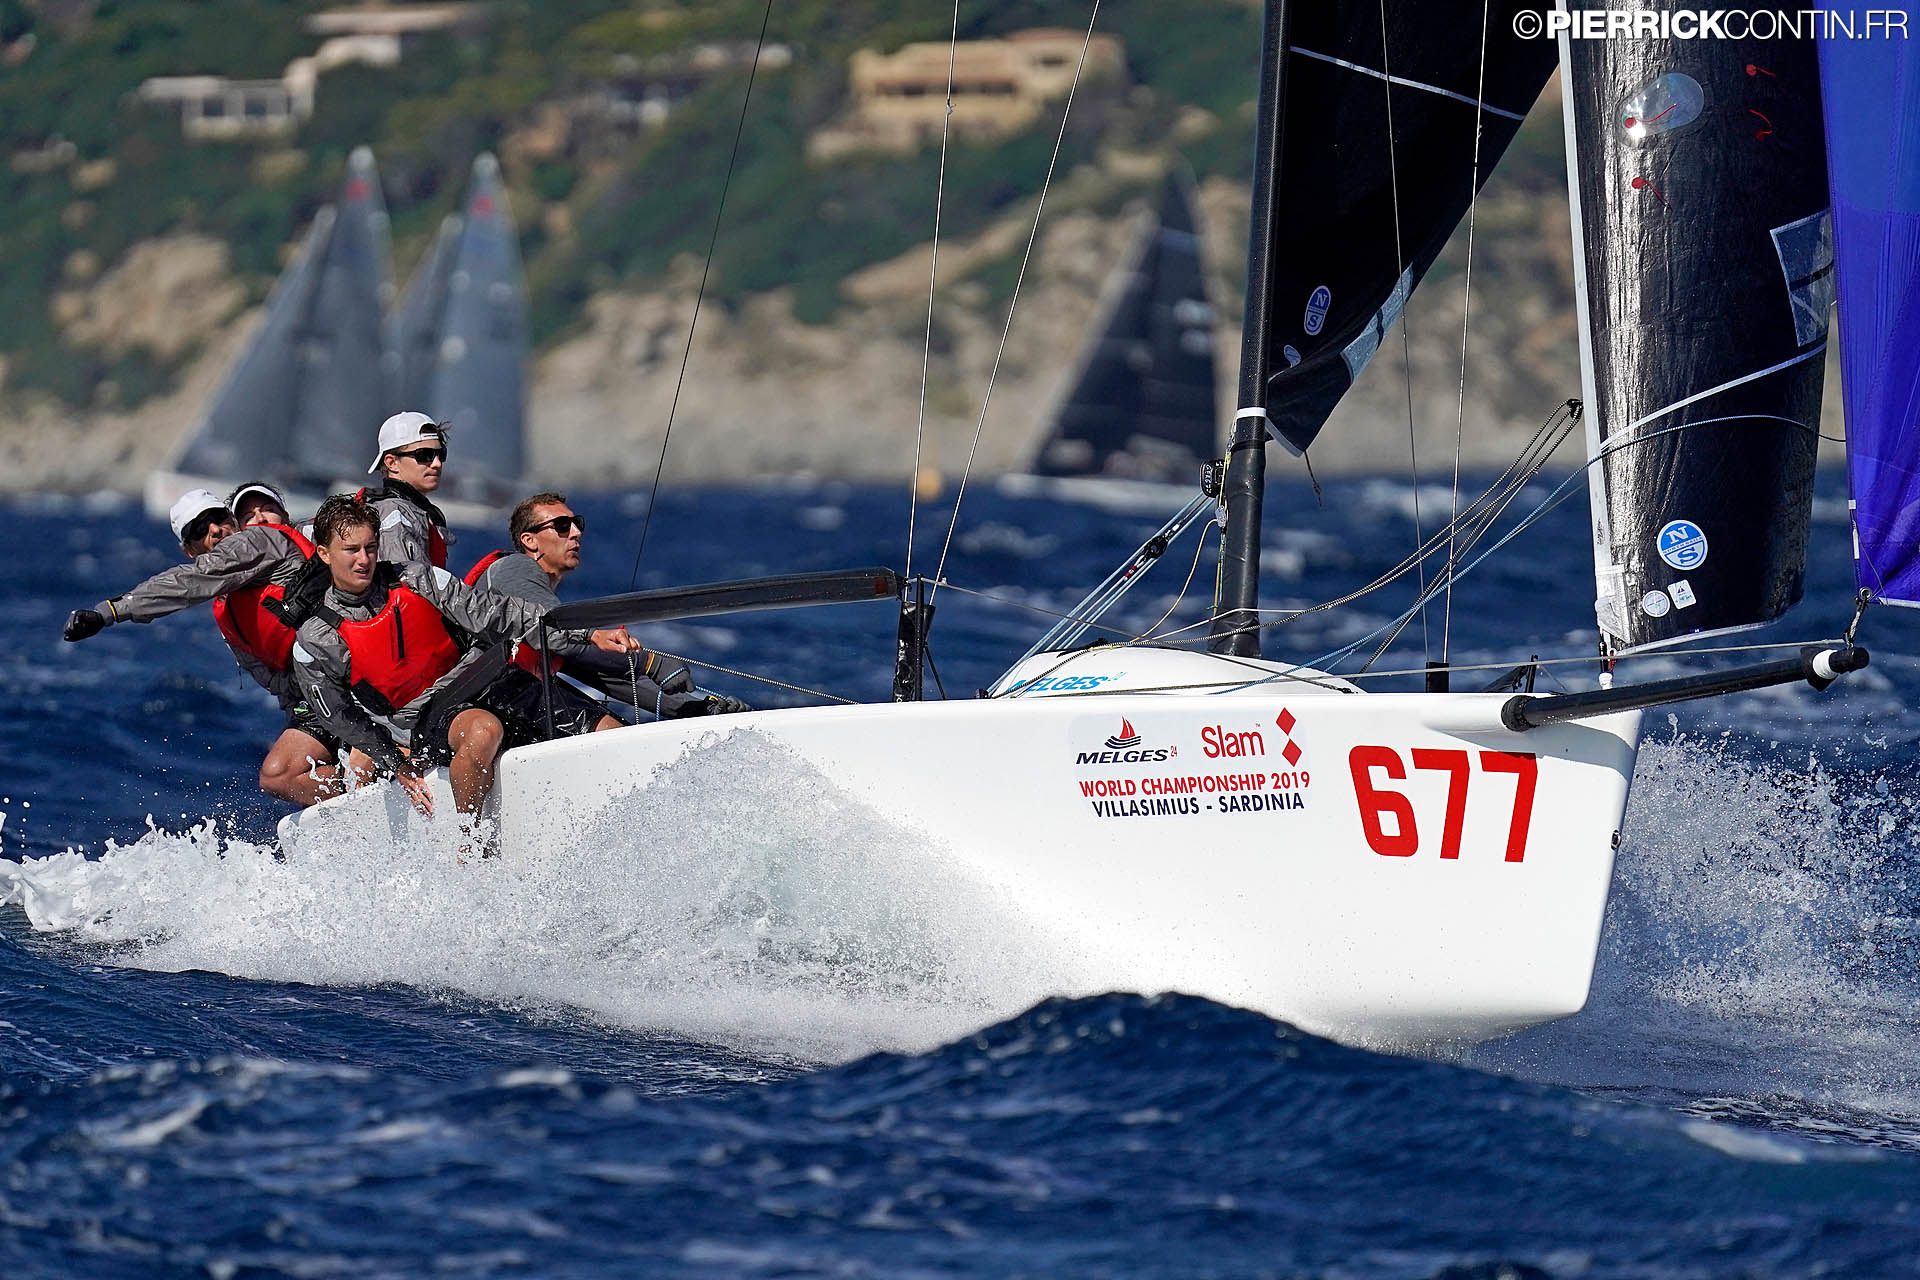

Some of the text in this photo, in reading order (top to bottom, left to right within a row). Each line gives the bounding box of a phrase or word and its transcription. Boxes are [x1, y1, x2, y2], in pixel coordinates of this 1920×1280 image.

[1315, 292, 1328, 307] N
[1308, 314, 1319, 328] S
[1666, 526, 1689, 545] N
[1677, 546, 1699, 564] S
[1201, 725, 1265, 759] Slam
[1076, 745, 1178, 765] MELGES 24
[1079, 771, 1311, 797] WORLD CHAMPIONSHIP 2019
[1091, 797, 1200, 818] VILLASIMIUS
[1219, 791, 1305, 814] SARDINIA
[1348, 745, 1538, 863] 677
